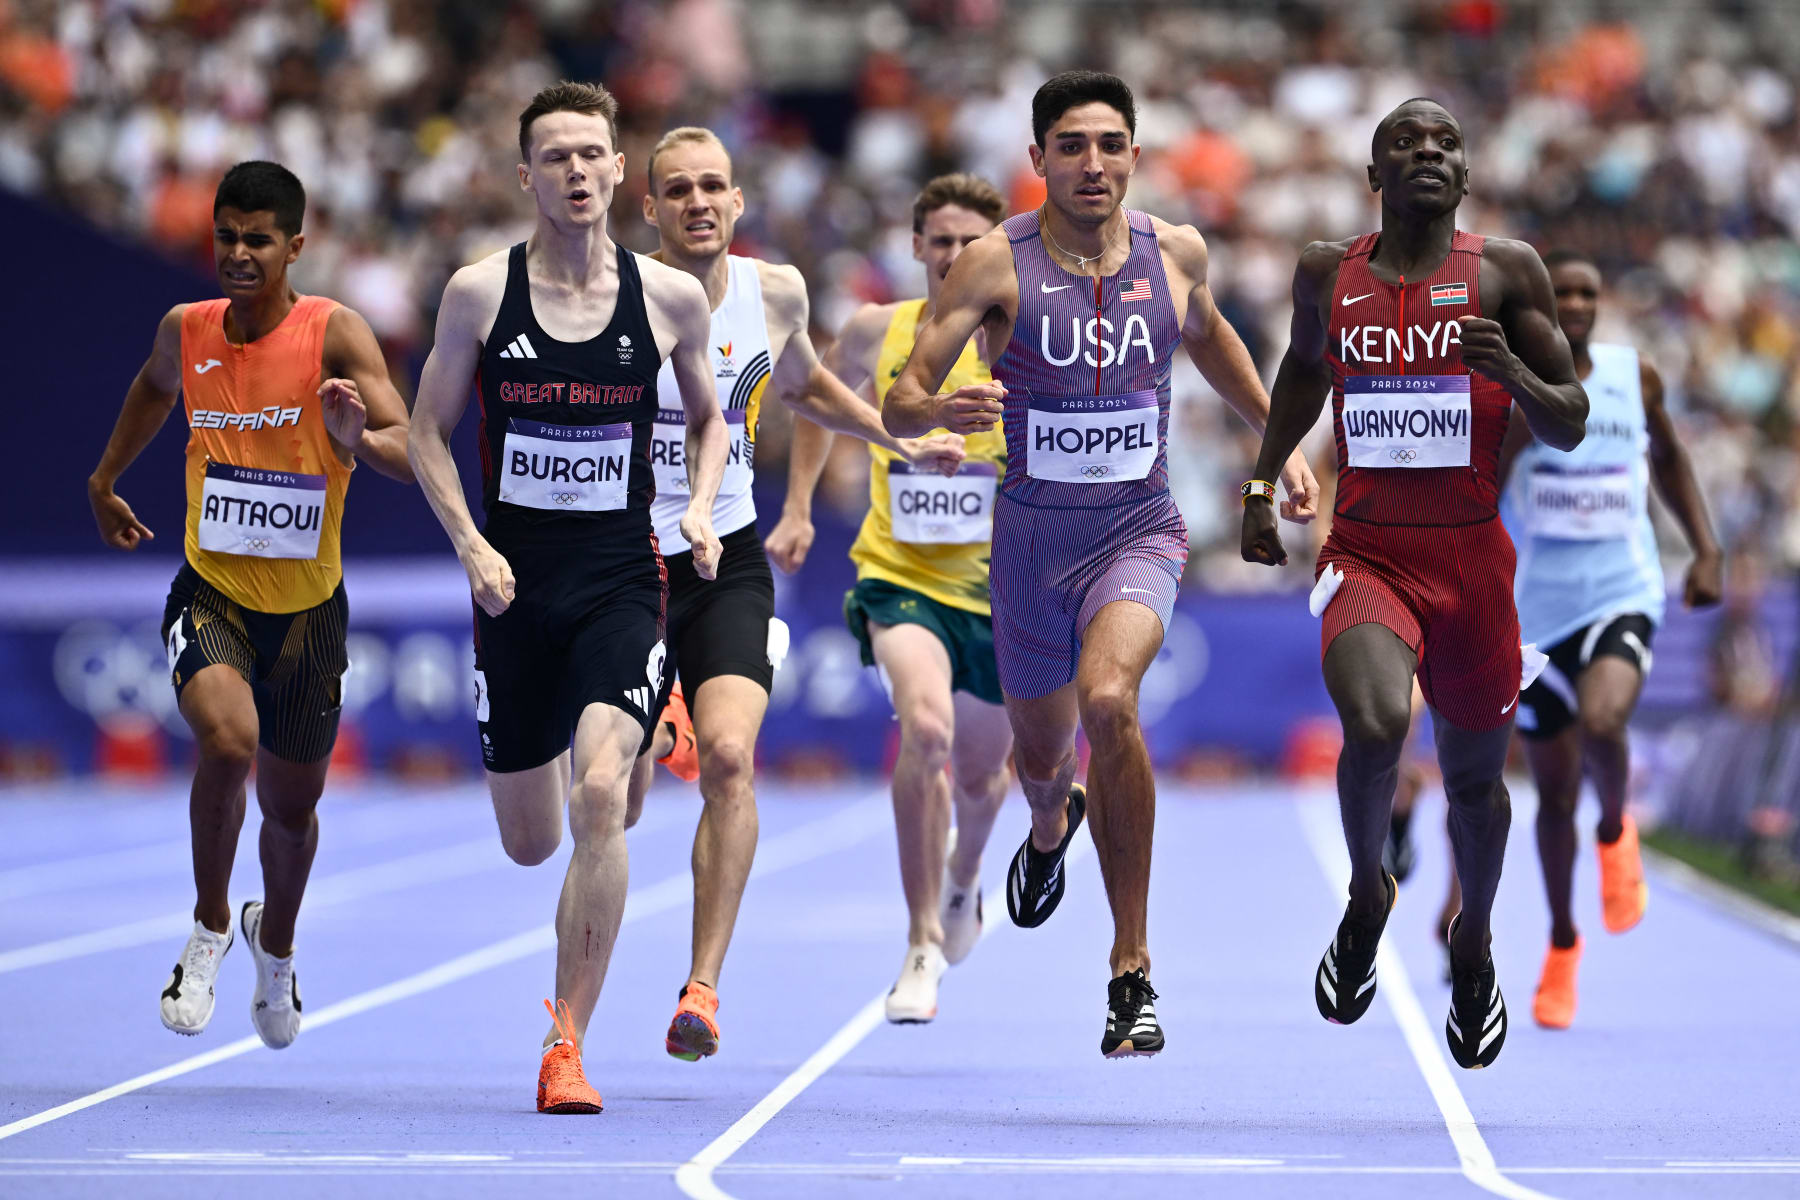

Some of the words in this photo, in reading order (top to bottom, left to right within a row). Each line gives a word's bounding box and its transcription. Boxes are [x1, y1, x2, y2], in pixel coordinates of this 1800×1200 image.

[1041, 313, 1156, 368] USA
[1341, 320, 1463, 364] KENYA
[500, 381, 566, 404] GREAT
[569, 383, 645, 405] BRITAIN
[1370, 380, 1402, 389] PARIS
[1405, 380, 1436, 389] 2024
[1062, 399, 1095, 409] PARIS
[1099, 399, 1127, 408] 2024
[190, 405, 303, 432] ESPAÑA
[540, 426, 572, 438] PARIS
[576, 430, 603, 438] 2024
[1346, 408, 1467, 439] WANYONYI
[1035, 422, 1153, 455] HOPPEL
[233, 469, 264, 481] PARIS
[267, 473, 296, 484] 2024
[510, 450, 625, 483] BURGIN
[204, 494, 321, 531] ATTAOUI
[899, 488, 982, 516] CRAIG
